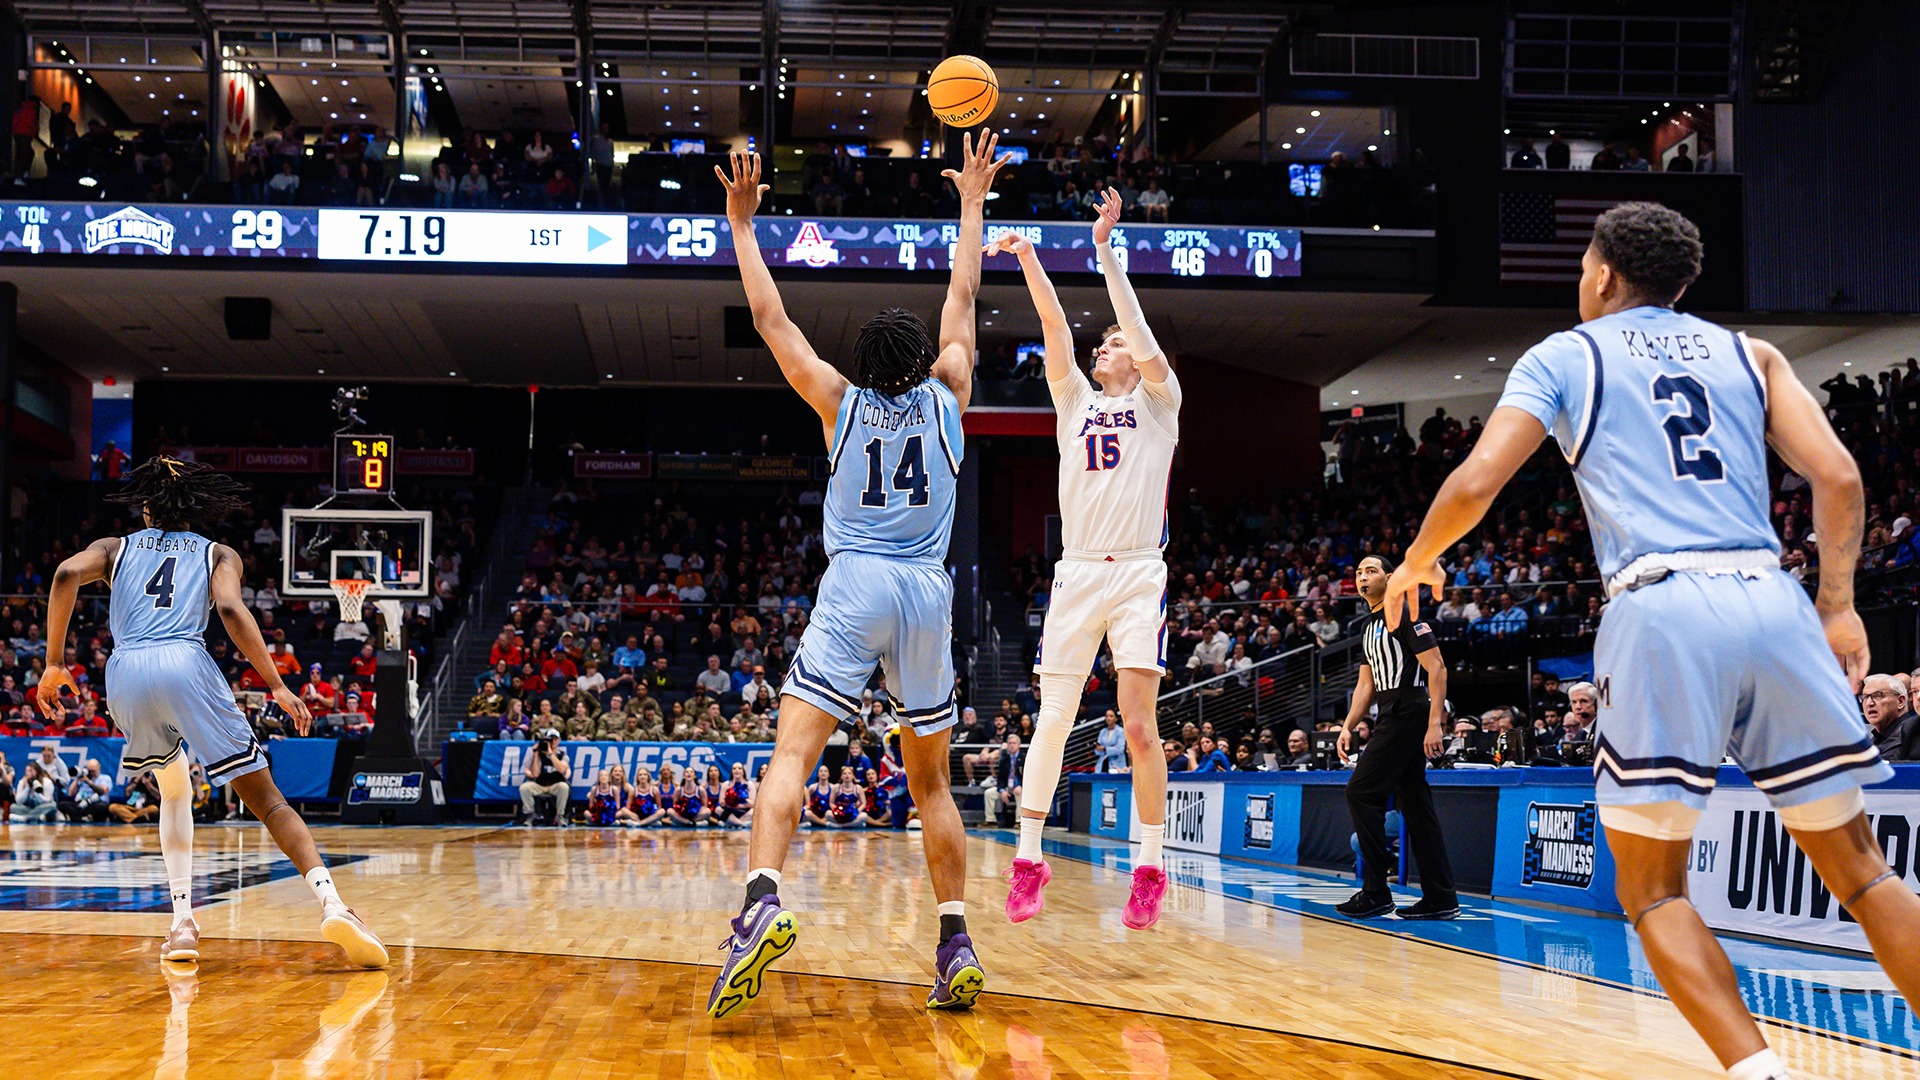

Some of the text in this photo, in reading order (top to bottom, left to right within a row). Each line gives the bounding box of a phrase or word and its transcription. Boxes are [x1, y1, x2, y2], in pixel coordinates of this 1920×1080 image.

[18, 206, 49, 224] TOL
[231, 209, 283, 250] 29
[22, 223, 42, 254] 4
[89, 219, 170, 249] THE MOUNT
[359, 214, 446, 256] 7:19
[529, 228, 562, 246] 1ST
[666, 218, 717, 258] 25
[893, 224, 924, 242] TOL
[941, 224, 961, 242] FL
[1164, 229, 1210, 248] 3PT%
[1247, 231, 1280, 249] FT%
[898, 241, 917, 270] 4
[1171, 246, 1206, 277] 46
[1254, 248, 1273, 279] 0
[1621, 329, 1711, 362] KEYES
[1649, 370, 1727, 486] 2
[246, 455, 308, 466] DAVIDSON
[352, 440, 388, 457] 7:19
[751, 458, 794, 468] GEORGE
[1085, 433, 1122, 472] 15
[365, 458, 383, 488] 8
[585, 459, 641, 471] FORDHAM
[739, 468, 808, 478] WASHINGTON
[859, 433, 931, 509] 14
[137, 536, 198, 553] ADEBAYO
[143, 555, 178, 611] 4
[499, 745, 716, 787] MDNESS
[365, 775, 404, 788] MARCH
[369, 786, 420, 799] MADNESS
[1175, 790, 1206, 844] FOUR
[1537, 809, 1576, 841] MARCH
[1541, 841, 1594, 876] MADNESS
[1697, 840, 1719, 873] BY
